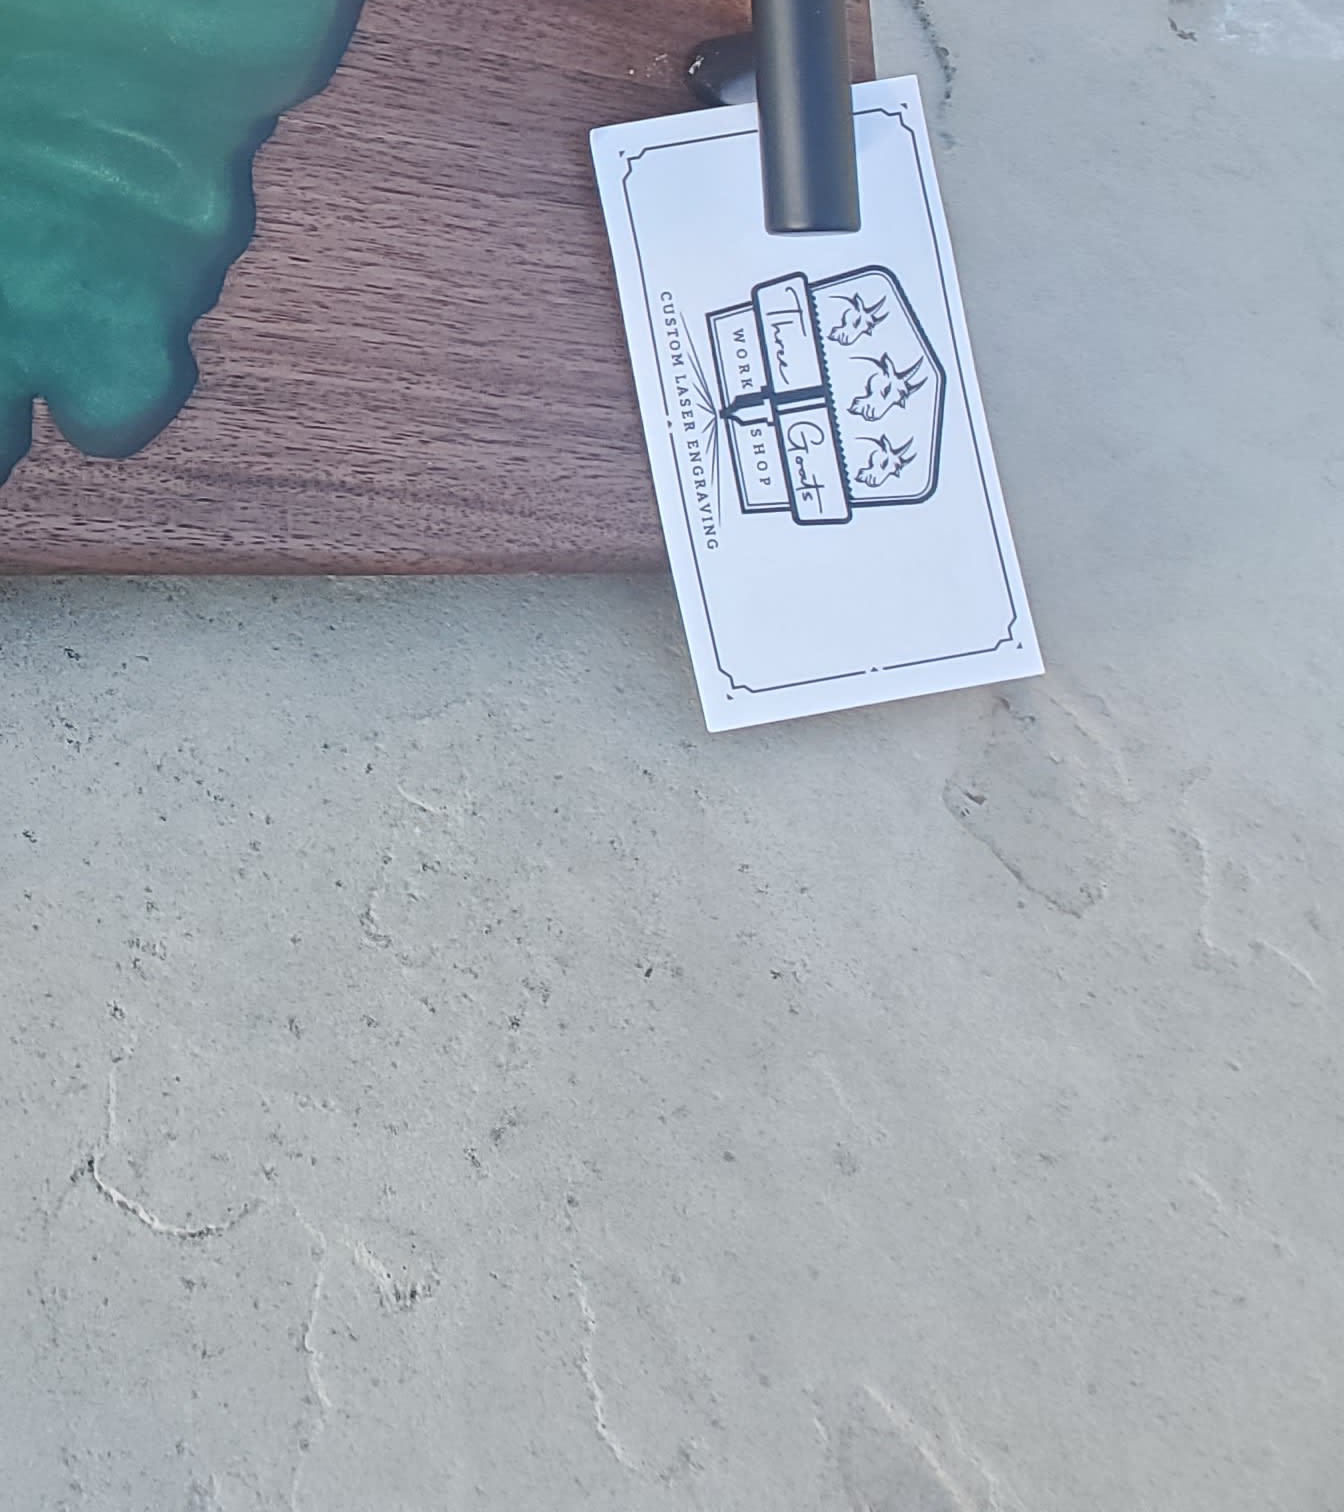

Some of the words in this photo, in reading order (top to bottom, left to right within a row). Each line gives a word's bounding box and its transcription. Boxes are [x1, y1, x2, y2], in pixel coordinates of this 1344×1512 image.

[660, 291, 685, 366] CUSTOM
[675, 375, 696, 433] LASER
[687, 440, 719, 550] ENGRAVING
[732, 328, 754, 389] WORK
[750, 428, 771, 487] SHOP
[766, 286, 807, 385] Three
[787, 421, 825, 514] Goats
